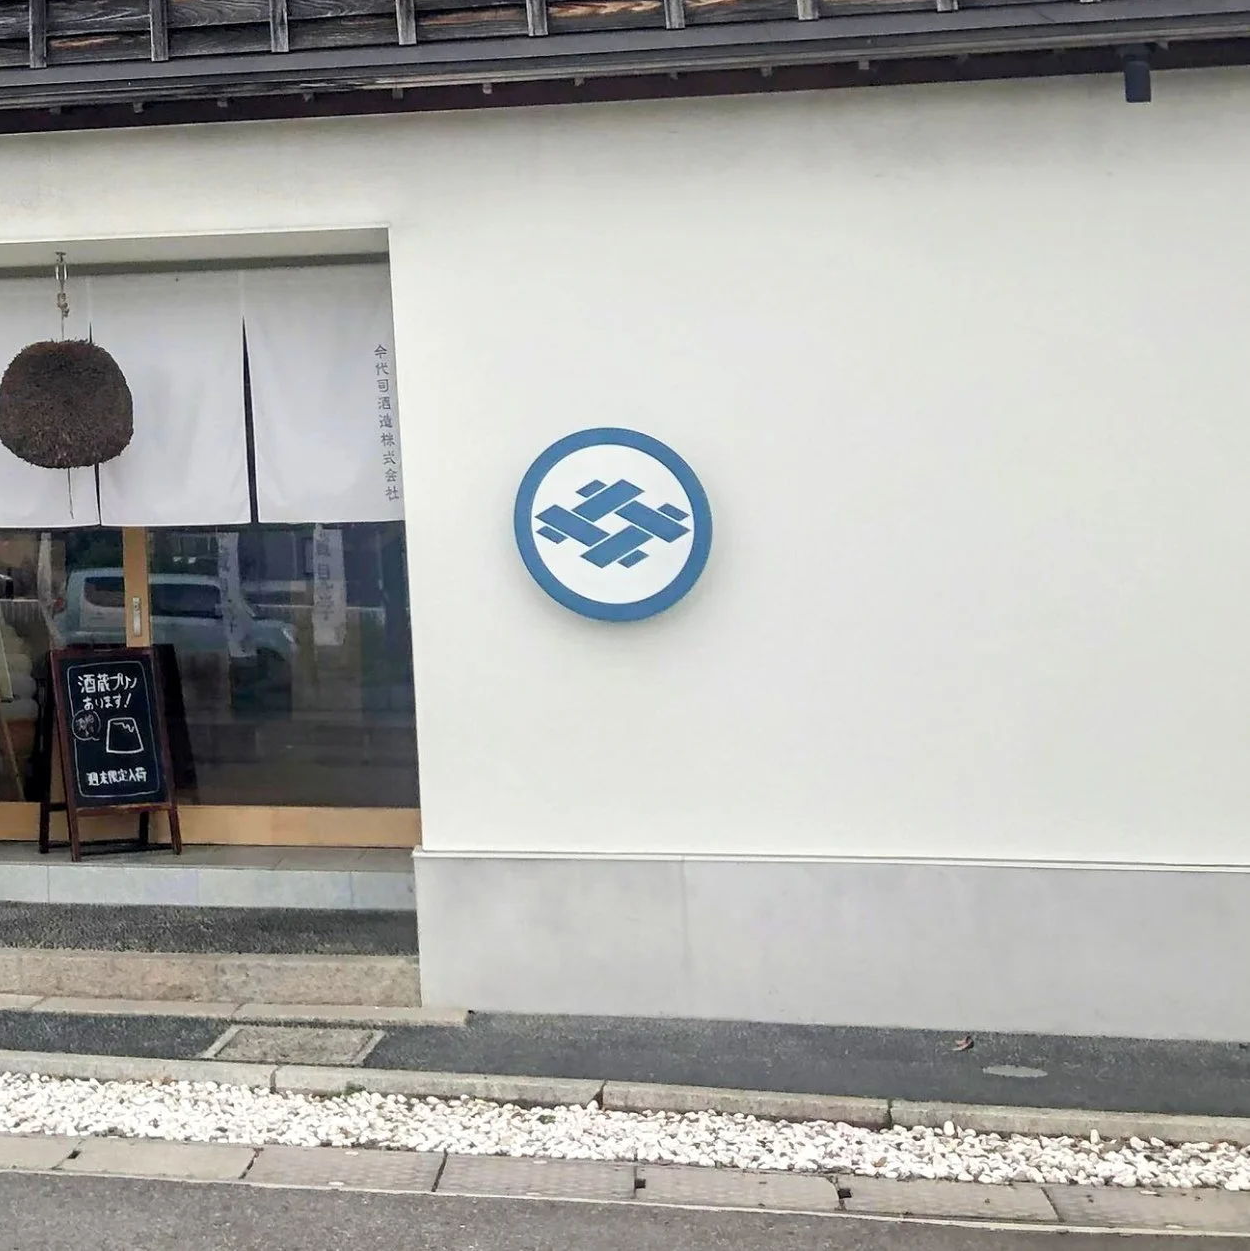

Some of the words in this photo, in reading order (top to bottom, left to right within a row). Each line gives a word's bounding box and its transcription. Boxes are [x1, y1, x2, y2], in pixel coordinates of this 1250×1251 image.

[374, 344, 400, 501] 今代司酒造株式会社
[77, 672, 138, 694] 酒蔵プリン
[82, 693, 132, 710] あります!
